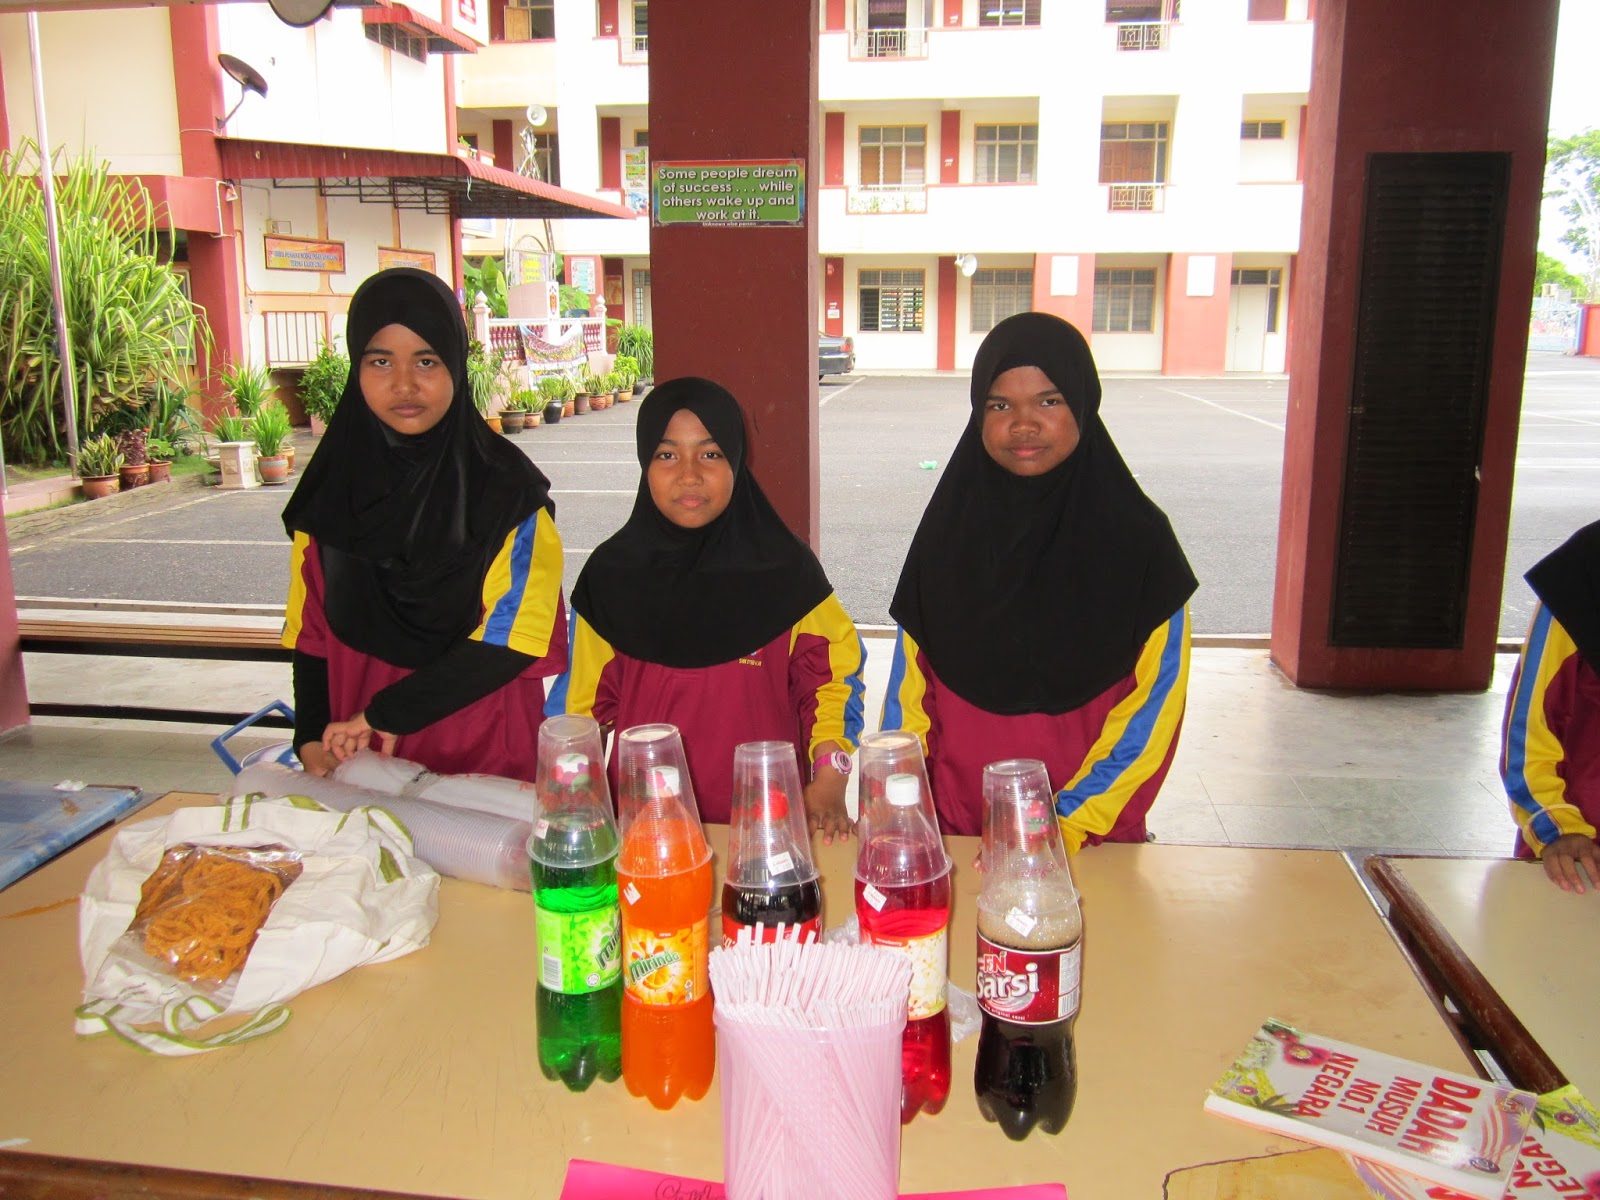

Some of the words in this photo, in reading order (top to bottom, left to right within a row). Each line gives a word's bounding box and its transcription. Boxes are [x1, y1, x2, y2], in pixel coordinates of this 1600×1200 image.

[659, 169, 697, 180] Some
[701, 167, 749, 181] people
[752, 167, 797, 178] dream
[662, 182, 676, 193] of
[679, 184, 732, 193] success
[759, 181, 794, 192] while
[662, 196, 703, 207] others
[706, 195, 743, 206] wake
[747, 197, 764, 207] up
[768, 195, 795, 206] and
[696, 208, 728, 220] work
[732, 209, 745, 220] at
[749, 209, 760, 220] it.
[629, 951, 681, 984] Mirinda
[977, 963, 1040, 999] Sarsi
[1293, 1053, 1359, 1118] NEGARA
[1337, 1078, 1382, 1115] NO.1
[1364, 1076, 1423, 1136] MUSUH
[1397, 1076, 1481, 1160] DADAH
